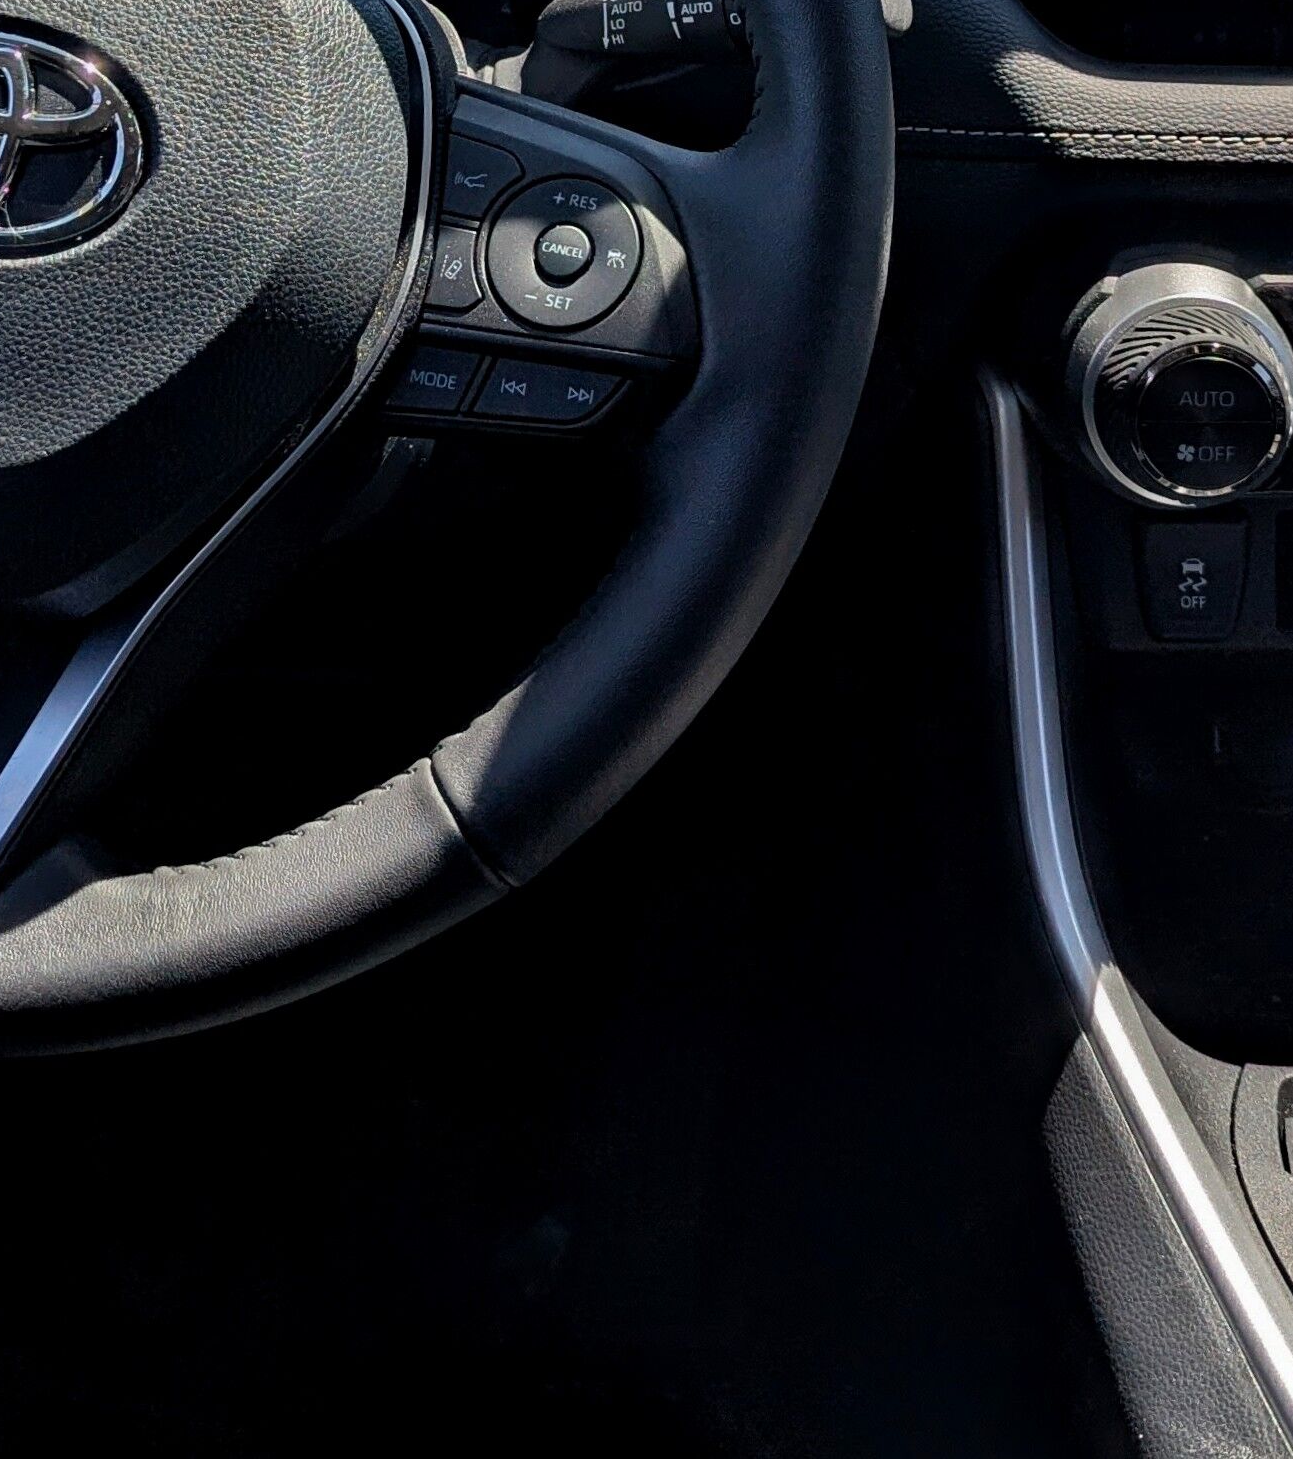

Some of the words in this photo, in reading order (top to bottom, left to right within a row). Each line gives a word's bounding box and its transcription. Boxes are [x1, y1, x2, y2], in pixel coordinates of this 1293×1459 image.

[611, 0, 643, 15] AUTO
[681, 1, 713, 15] AUTO
[610, 18, 625, 30] LO
[611, 33, 625, 45] HI
[568, 193, 598, 211] RES
[541, 240, 584, 260] CANCEL
[544, 294, 574, 311] SET
[409, 368, 458, 391] MODE
[1179, 390, 1235, 407] AUTO
[1198, 445, 1236, 461] OFF
[1180, 595, 1207, 609] OFF
